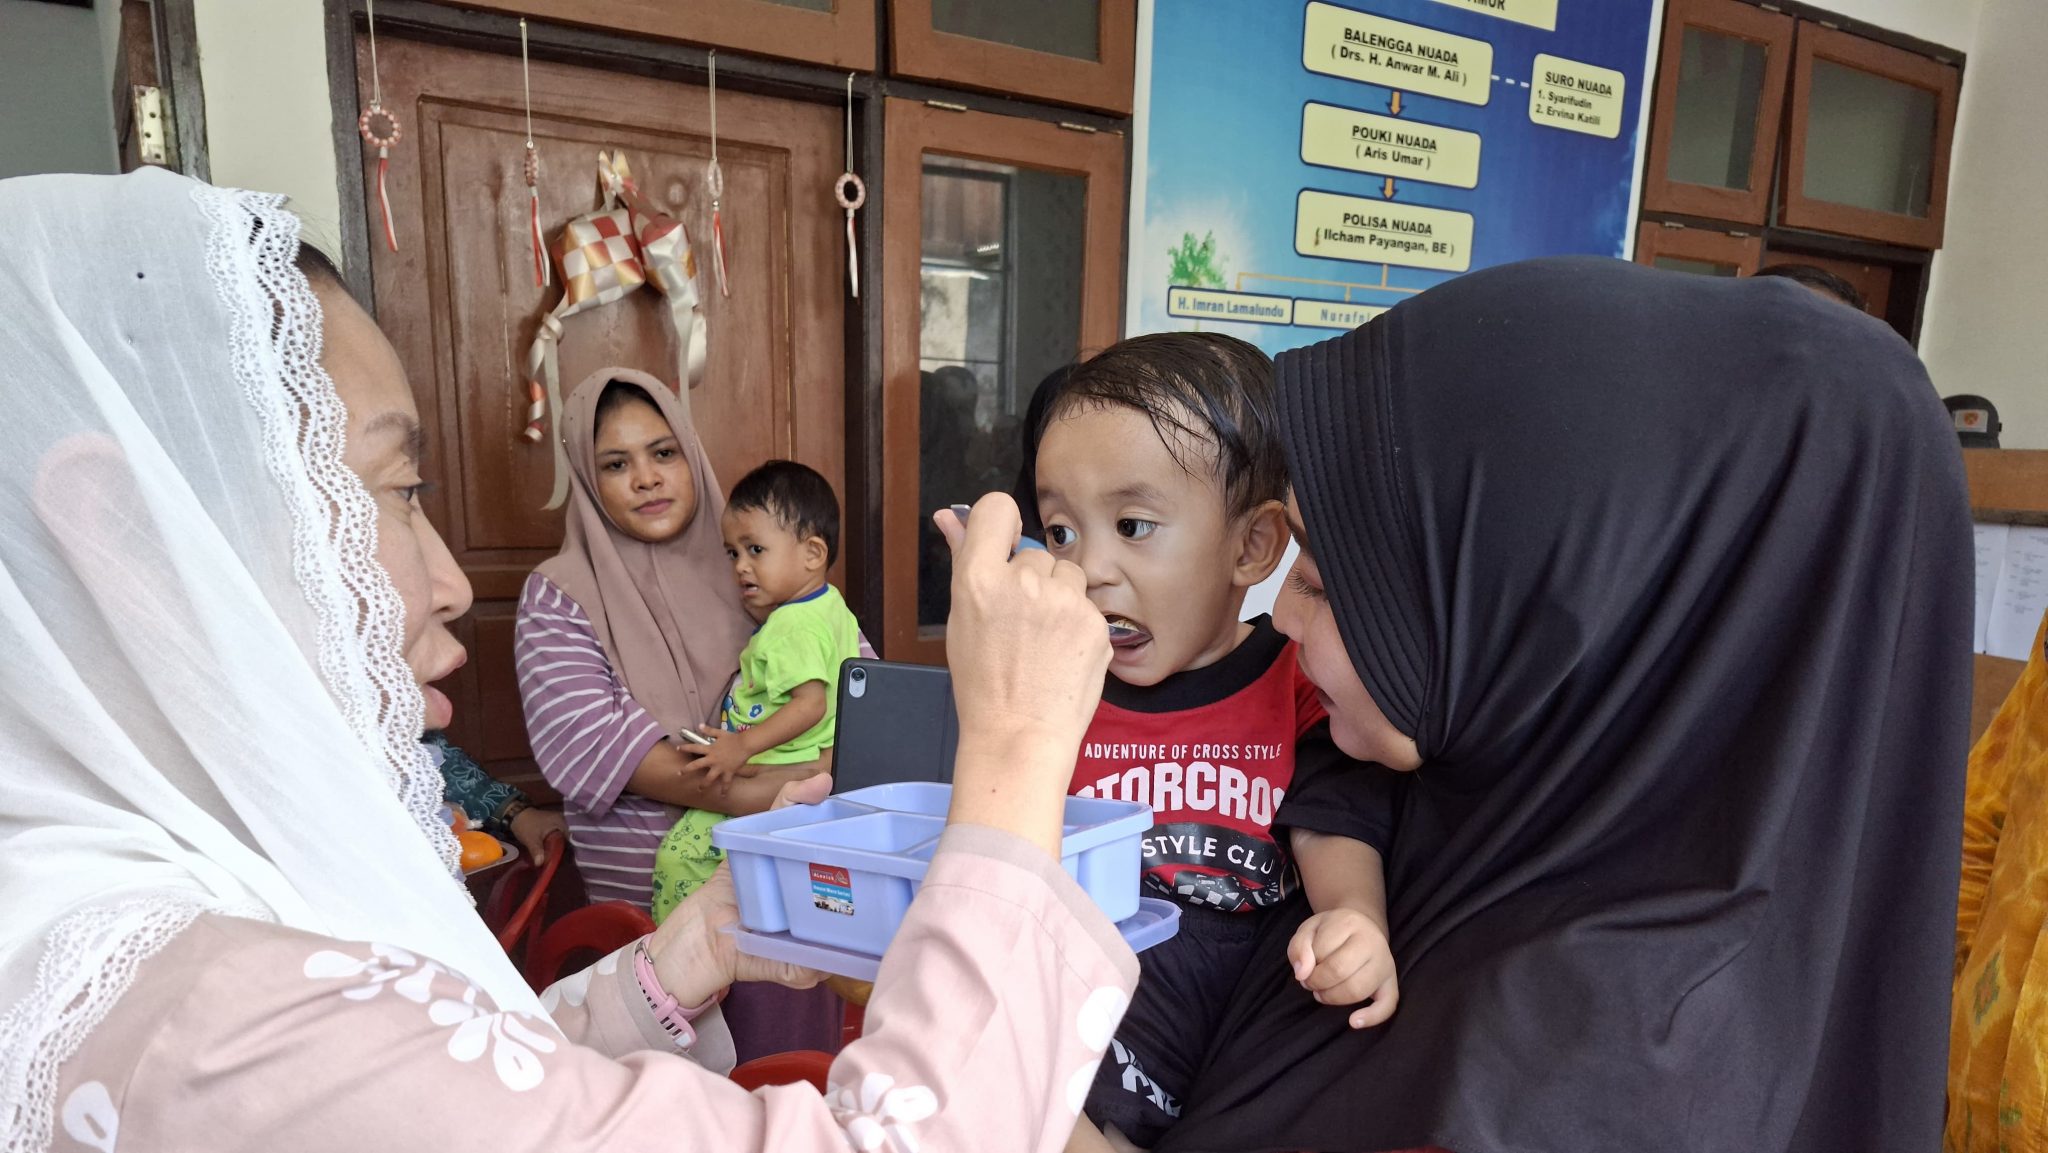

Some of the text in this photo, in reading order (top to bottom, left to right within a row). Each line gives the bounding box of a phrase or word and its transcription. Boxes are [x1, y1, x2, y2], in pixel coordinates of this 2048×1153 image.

[1344, 27, 1459, 64] BALENGGA NUADA
[1340, 46, 1365, 62] Drs.
[1369, 53, 1382, 65] H.
[1386, 57, 1424, 75] Anwar
[1427, 65, 1440, 78] M.
[1444, 69, 1459, 82] Ali
[1545, 71, 1612, 96] SURO NUADA
[1538, 89, 1592, 109] 1. Syarifudin
[1536, 103, 1543, 114] 2.
[1546, 106, 1575, 120] Ervina
[1352, 125, 1437, 151] POUKI NUADA
[1364, 146, 1387, 160] Aris
[1392, 150, 1423, 166] Umar
[1343, 213, 1433, 235] POLISA NUADA
[1369, 233, 1428, 253] Payangan,
[1432, 242, 1447, 254] BE
[1178, 297, 1284, 318] H. Imran Lamalundu
[1084, 743, 1282, 760] ADVENTURE OF CROSS STYLE
[1076, 761, 1285, 826] TORCRO
[1142, 835, 1274, 875] STYLE CLU
